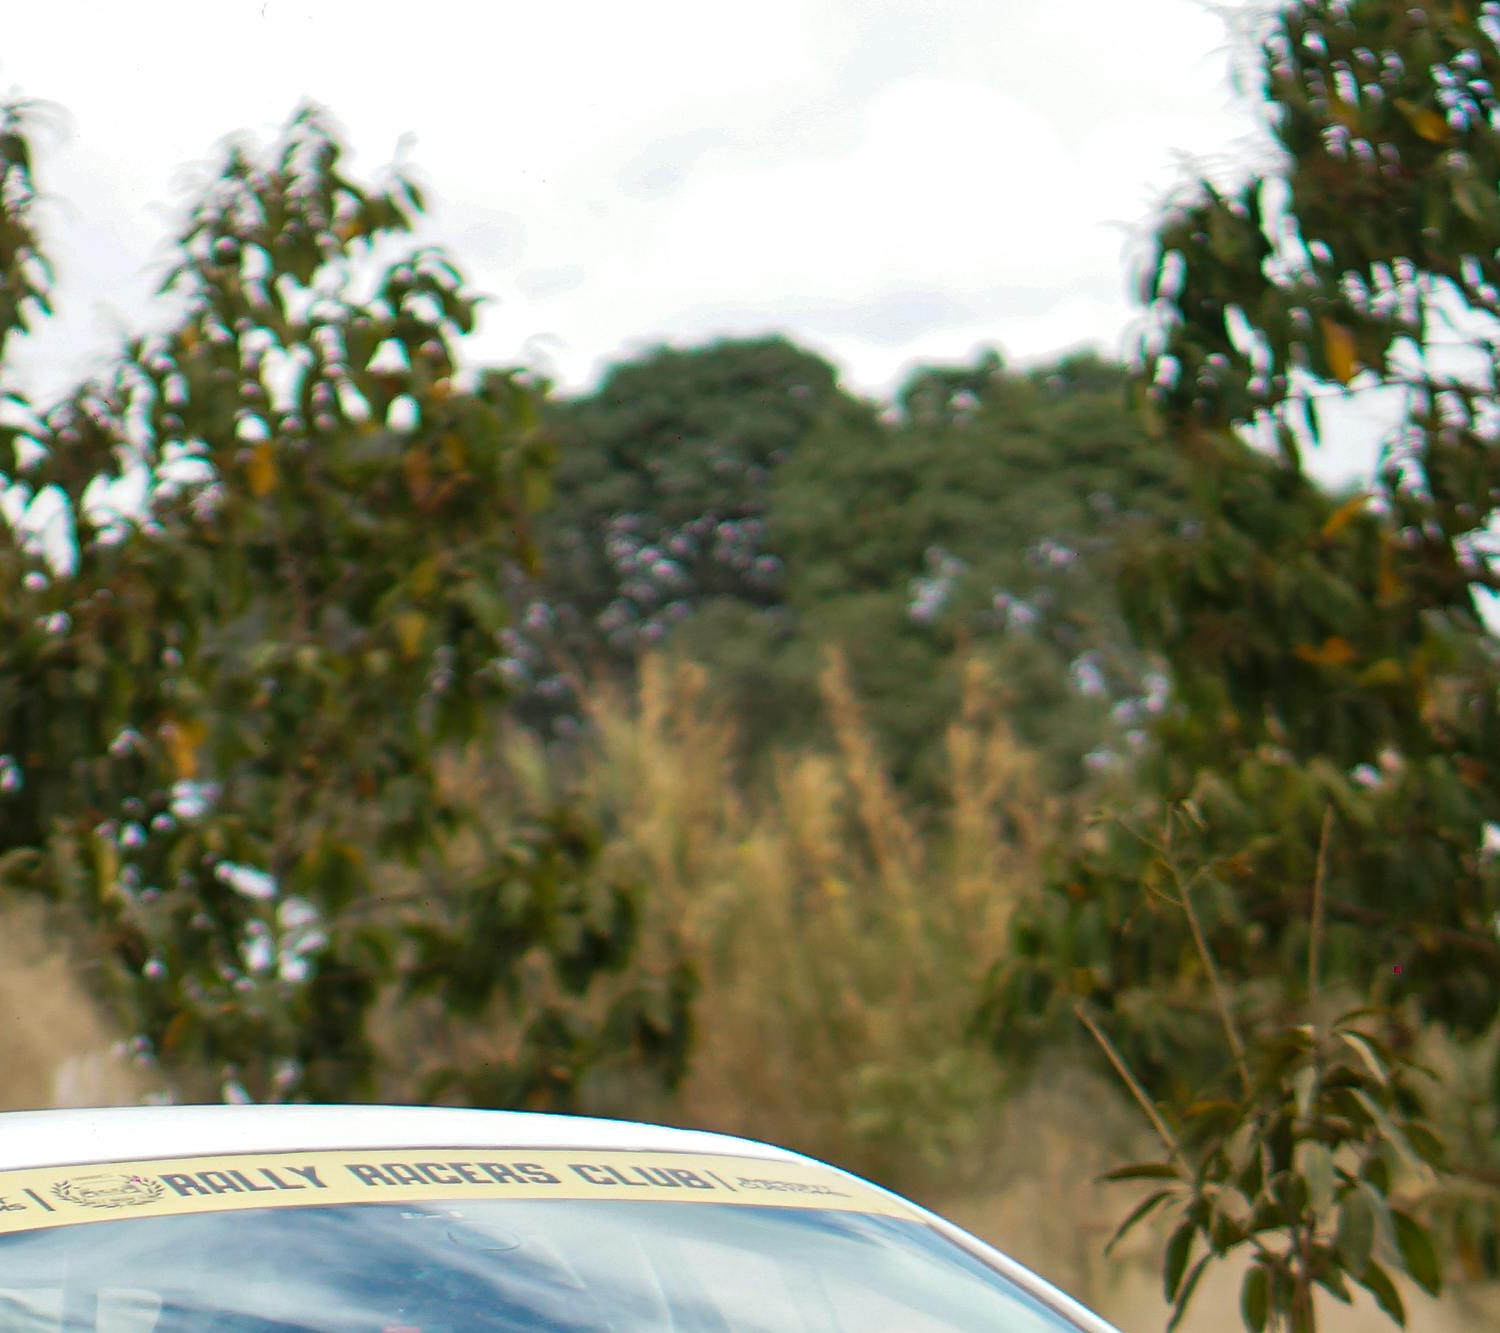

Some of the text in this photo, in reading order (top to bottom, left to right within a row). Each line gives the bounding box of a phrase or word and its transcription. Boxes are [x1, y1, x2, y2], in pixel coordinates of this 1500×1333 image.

[158, 1165, 328, 1197] RALLY
[344, 1161, 562, 1187] RACERS
[568, 1163, 715, 1190] CLUB
